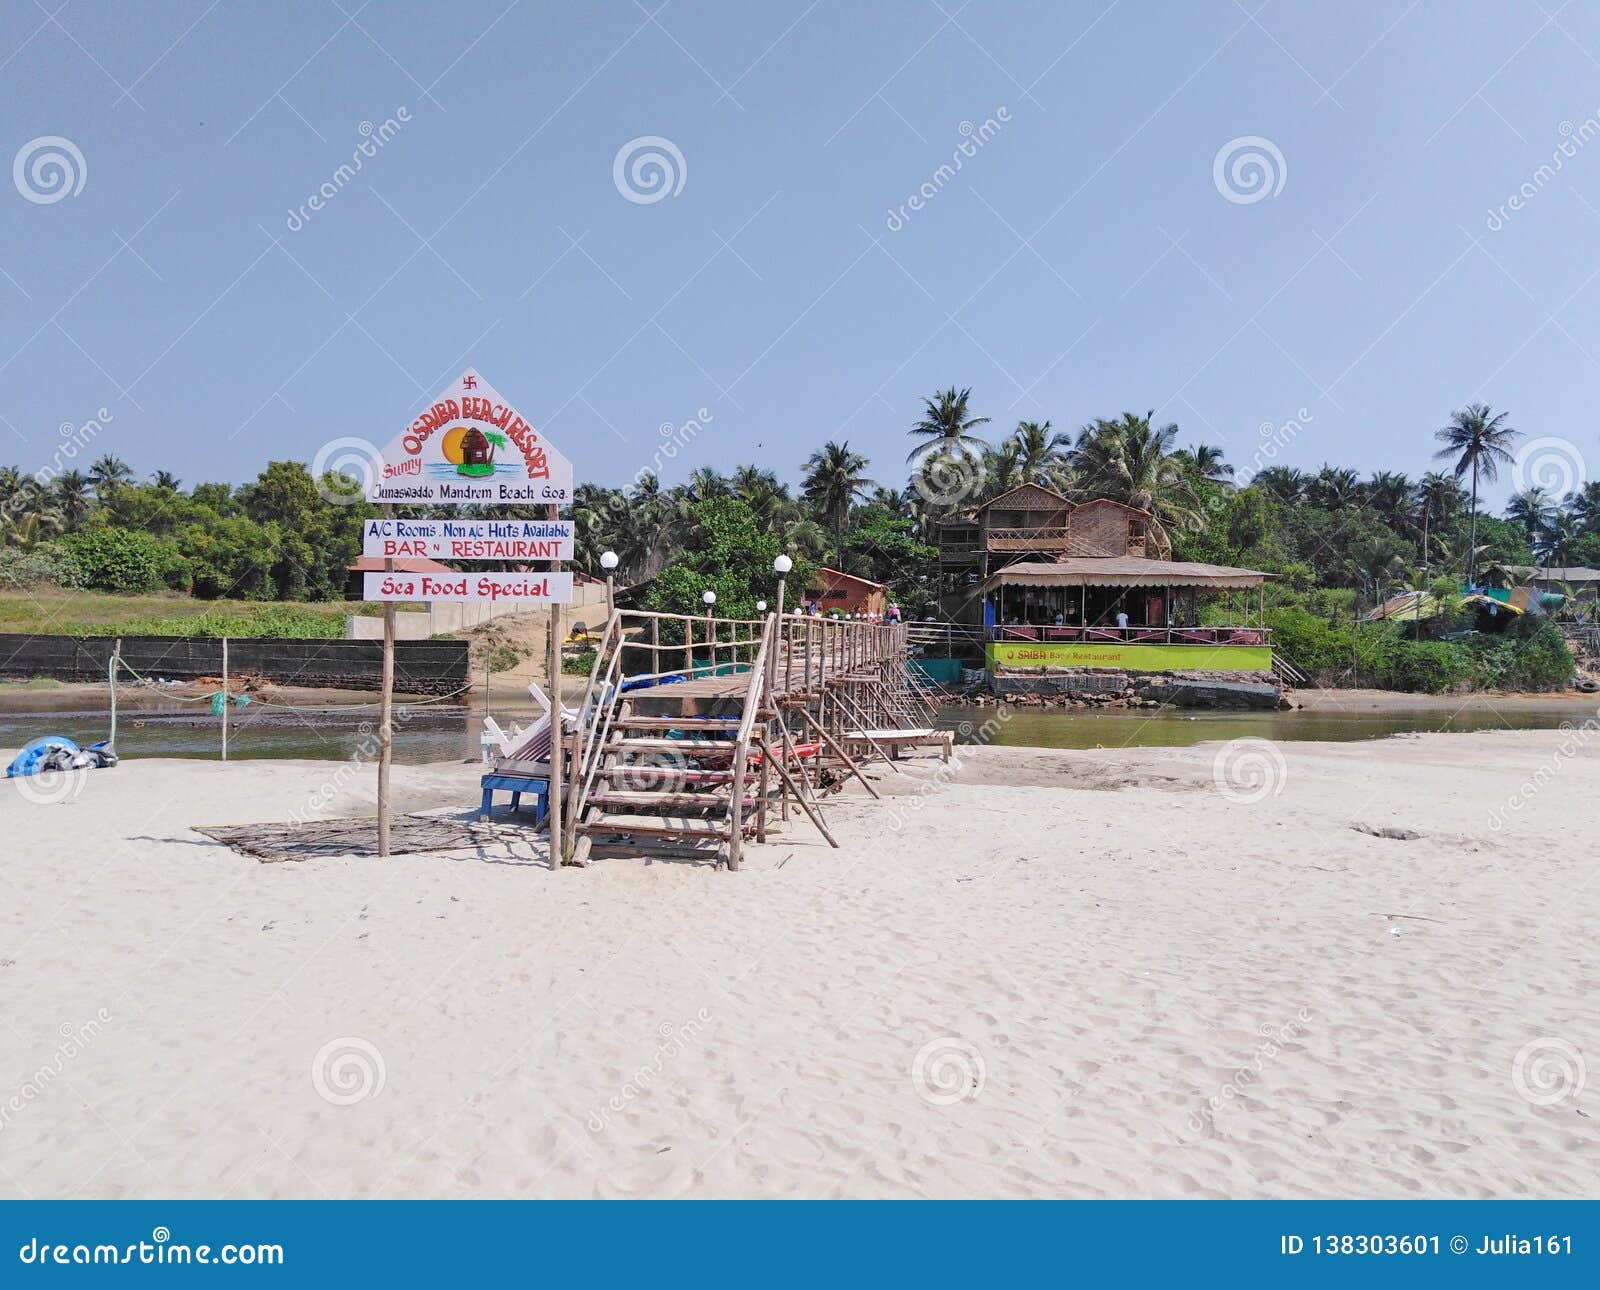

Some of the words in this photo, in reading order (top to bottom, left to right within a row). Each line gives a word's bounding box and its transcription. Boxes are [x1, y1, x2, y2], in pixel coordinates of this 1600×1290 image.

[462, 397, 513, 430] BEACH
[505, 417, 550, 480] RESORT
[382, 457, 422, 480] Sunny
[440, 484, 492, 500] Mandrem
[499, 484, 534, 500] Beach
[369, 521, 392, 539] A/C
[443, 522, 466, 538] Non
[488, 523, 519, 538] Huts
[522, 523, 570, 538] Available
[383, 540, 428, 557] BAR
[452, 540, 562, 558] RESTAURANT
[380, 576, 415, 596] Sea
[422, 577, 469, 596] Food
[477, 577, 550, 600] Special
[1017, 649, 1047, 660] SAIBA
